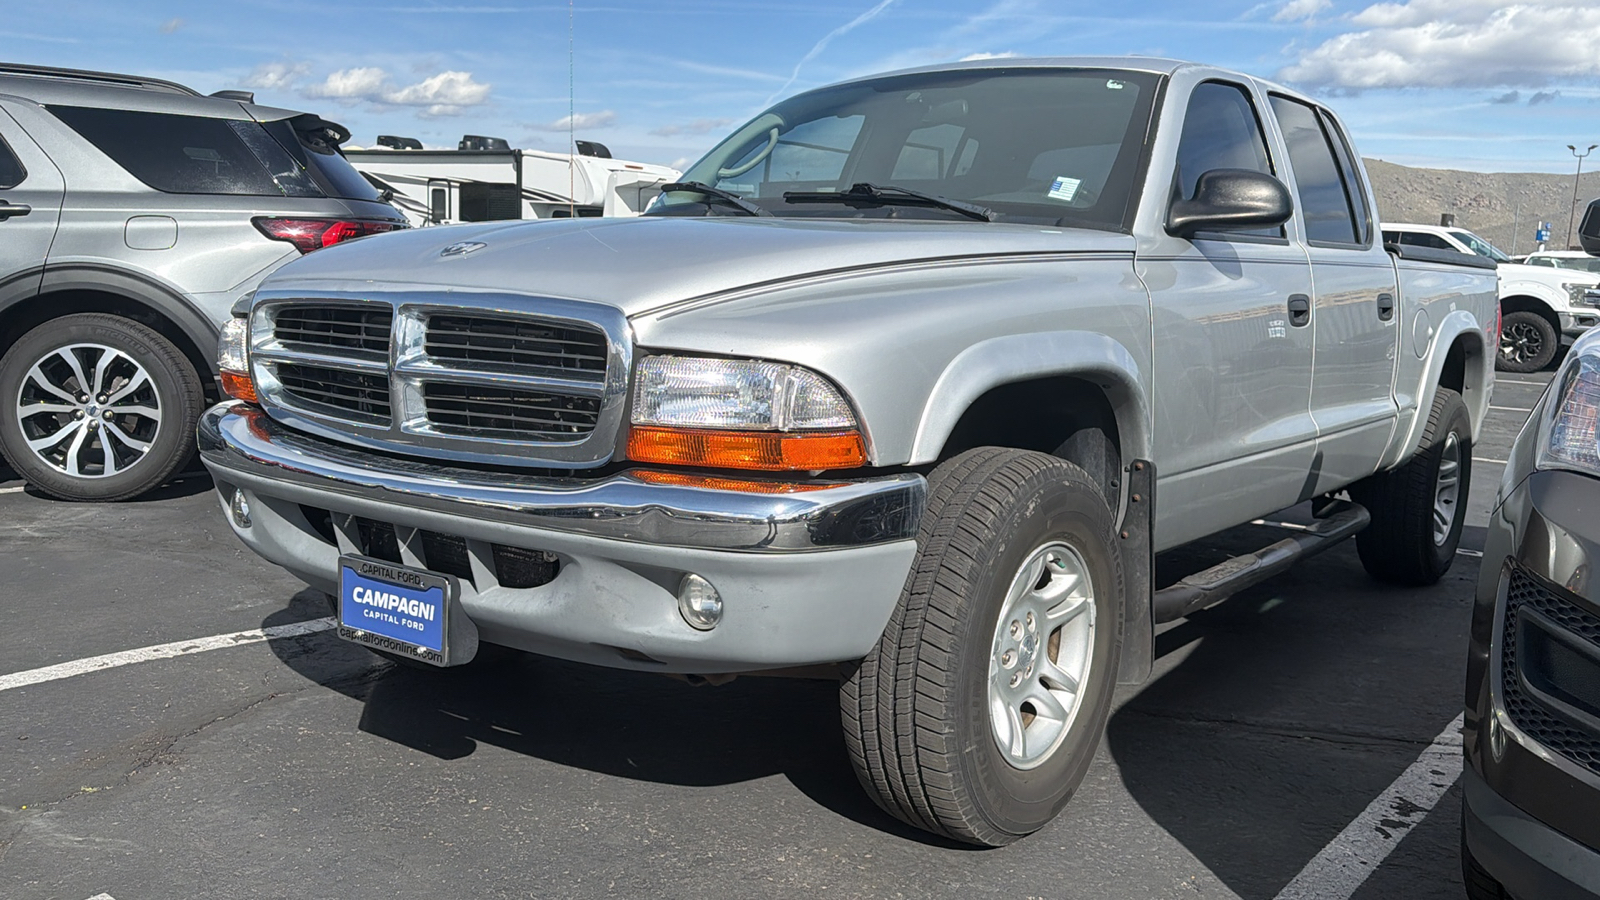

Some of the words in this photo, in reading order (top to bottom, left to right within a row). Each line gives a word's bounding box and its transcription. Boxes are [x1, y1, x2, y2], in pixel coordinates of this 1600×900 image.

[363, 564, 395, 580] CAPITAL
[398, 572, 420, 585] FORD
[1110, 537, 1123, 636] MICHELIN
[353, 587, 435, 621] CAMPAGNI
[364, 610, 399, 625] CAPITAL
[402, 618, 425, 631] FORD
